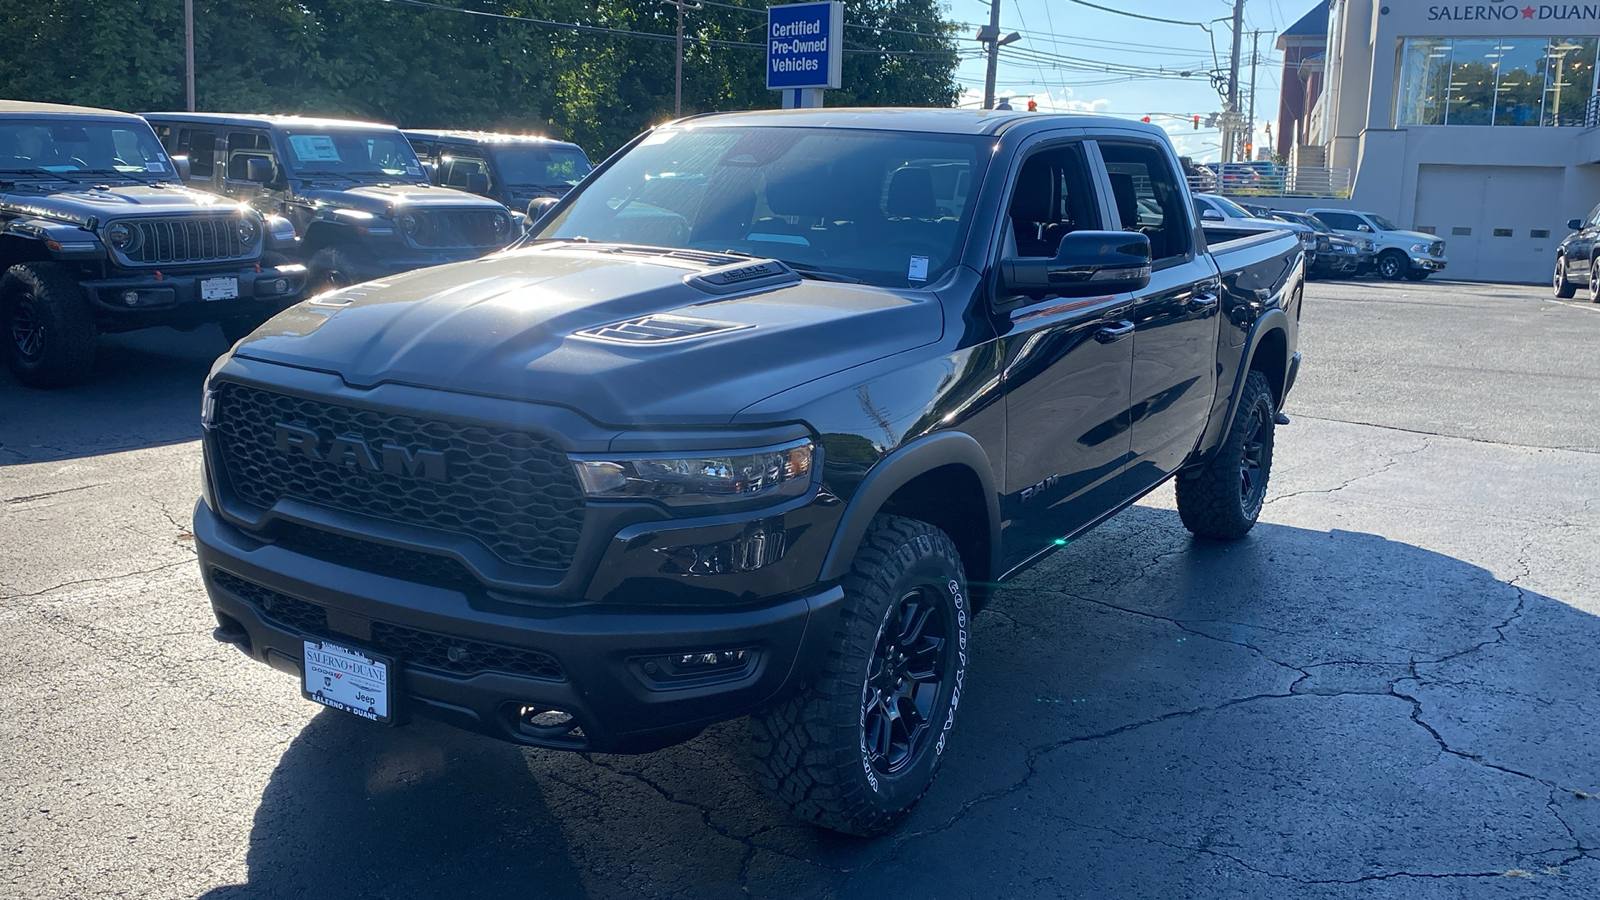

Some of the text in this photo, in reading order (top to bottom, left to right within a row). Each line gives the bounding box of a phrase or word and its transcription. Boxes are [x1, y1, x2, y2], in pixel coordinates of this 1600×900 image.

[1428, 5, 1600, 21] SALERNO DUAN
[772, 20, 820, 37] Certified
[772, 37, 827, 54] Pre-Owned
[772, 57, 819, 72] Vehicles
[275, 421, 448, 482] RAM
[1020, 473, 1059, 503] RAM
[307, 650, 386, 682] SALERNO DUANE
[935, 579, 967, 756] GOODYEAR
[311, 693, 378, 721] SALERNO DUANE
[355, 691, 375, 705] Jeep
